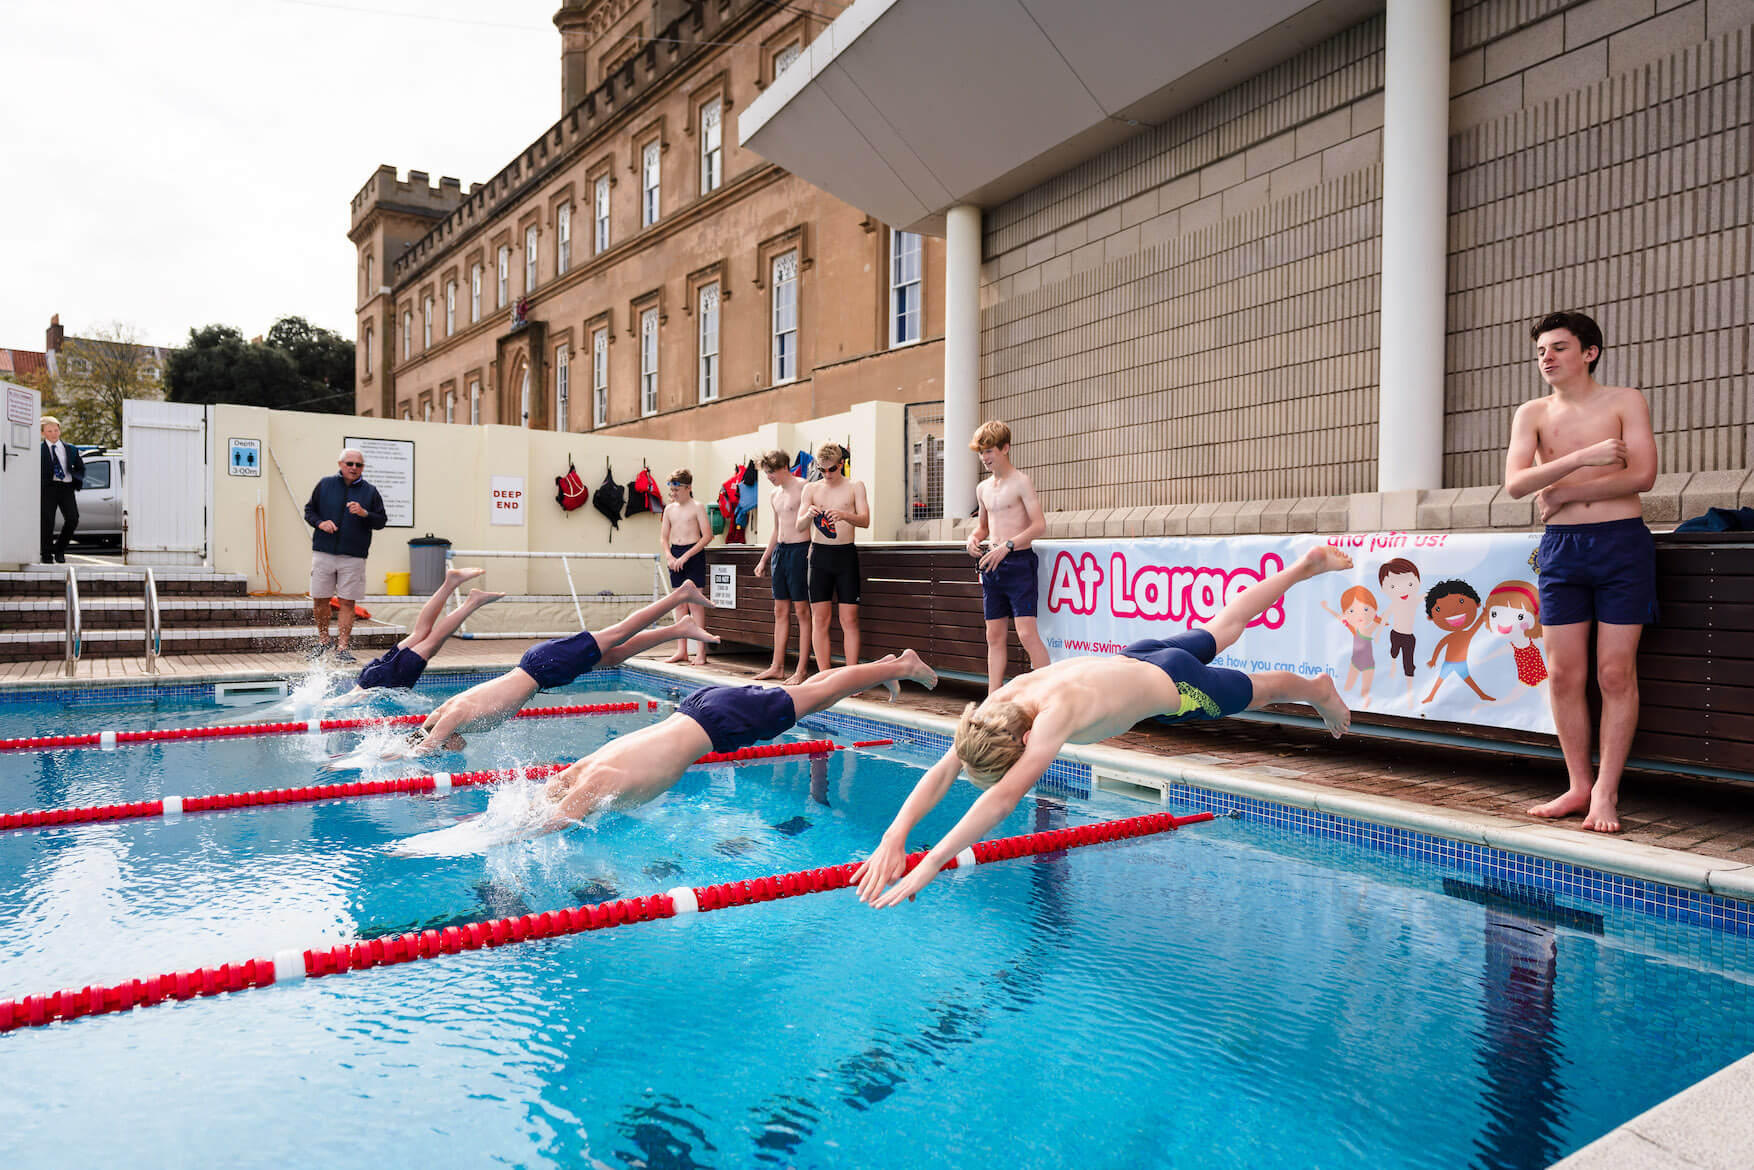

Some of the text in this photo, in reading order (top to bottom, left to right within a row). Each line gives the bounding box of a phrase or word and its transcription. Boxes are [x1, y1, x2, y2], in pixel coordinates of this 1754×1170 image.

[493, 490, 522, 498] DEEP
[496, 501, 519, 509] END
[1048, 551, 1104, 615] At
[1047, 637, 1129, 654] Visit www.swim
[1226, 655, 1247, 668] how
[1251, 660, 1271, 672] you
[1273, 662, 1295, 672] can
[1298, 661, 1322, 675] dive
[1325, 664, 1339, 678] in.
